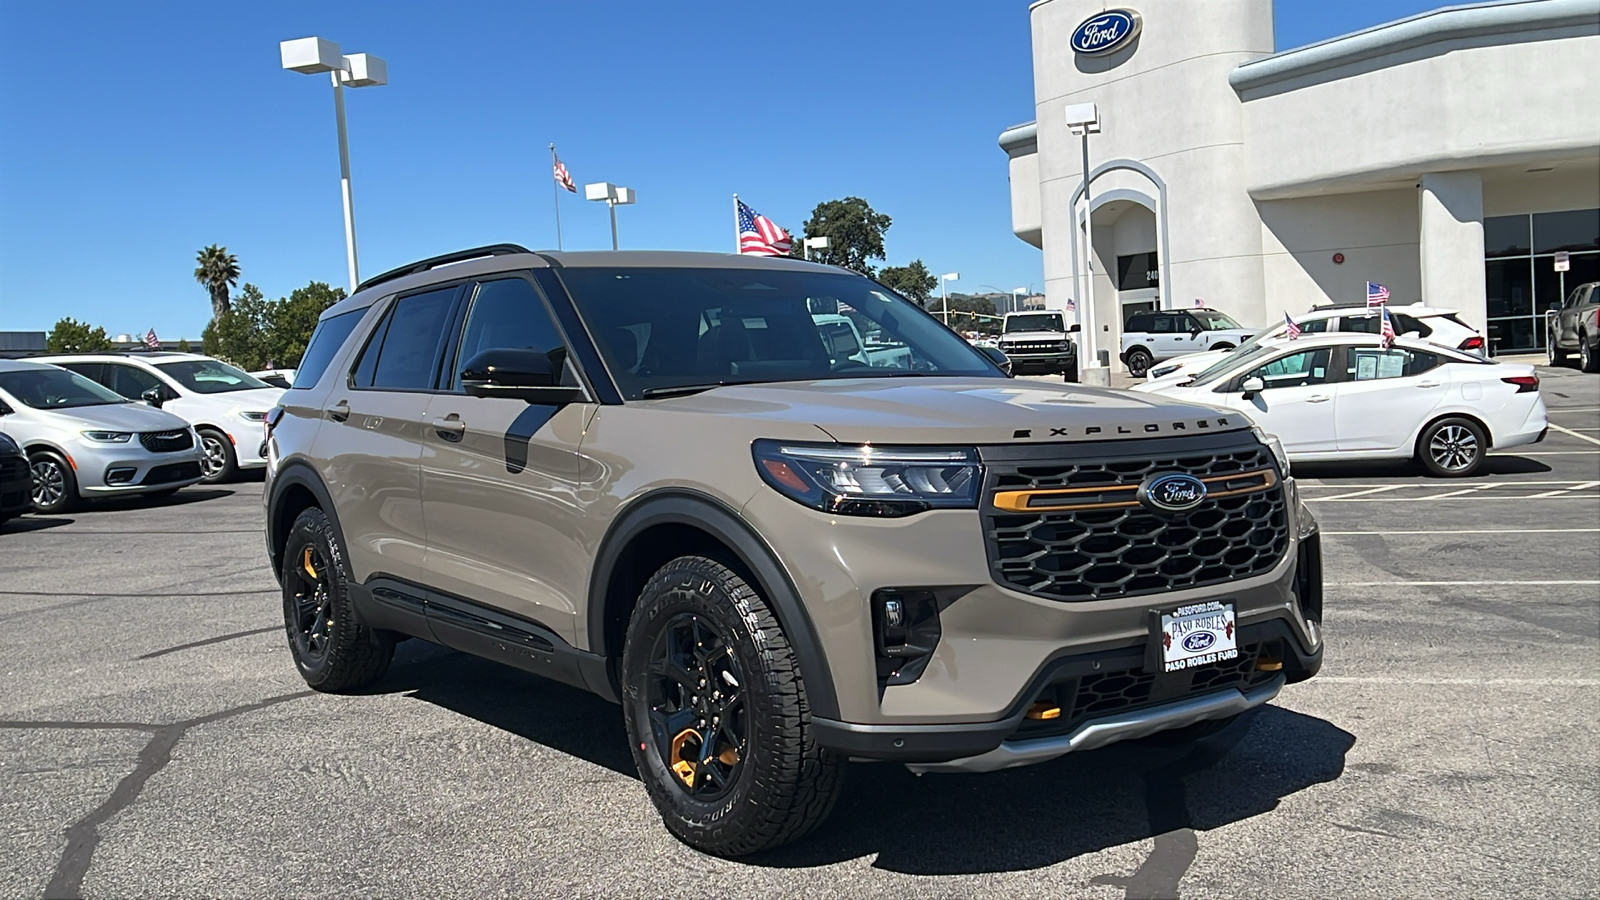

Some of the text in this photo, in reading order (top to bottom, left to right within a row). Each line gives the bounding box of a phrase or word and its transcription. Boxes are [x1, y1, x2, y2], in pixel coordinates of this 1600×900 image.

[1081, 18, 1119, 48] Ford
[1013, 418, 1229, 438] EXPLORER
[1164, 482, 1195, 502] Ford
[1177, 601, 1220, 616] PASOFORD.COM
[1172, 614, 1228, 639] PASO ROBLES
[1188, 633, 1211, 649] Ford
[1165, 649, 1238, 673] PASO ROBLES FORD
